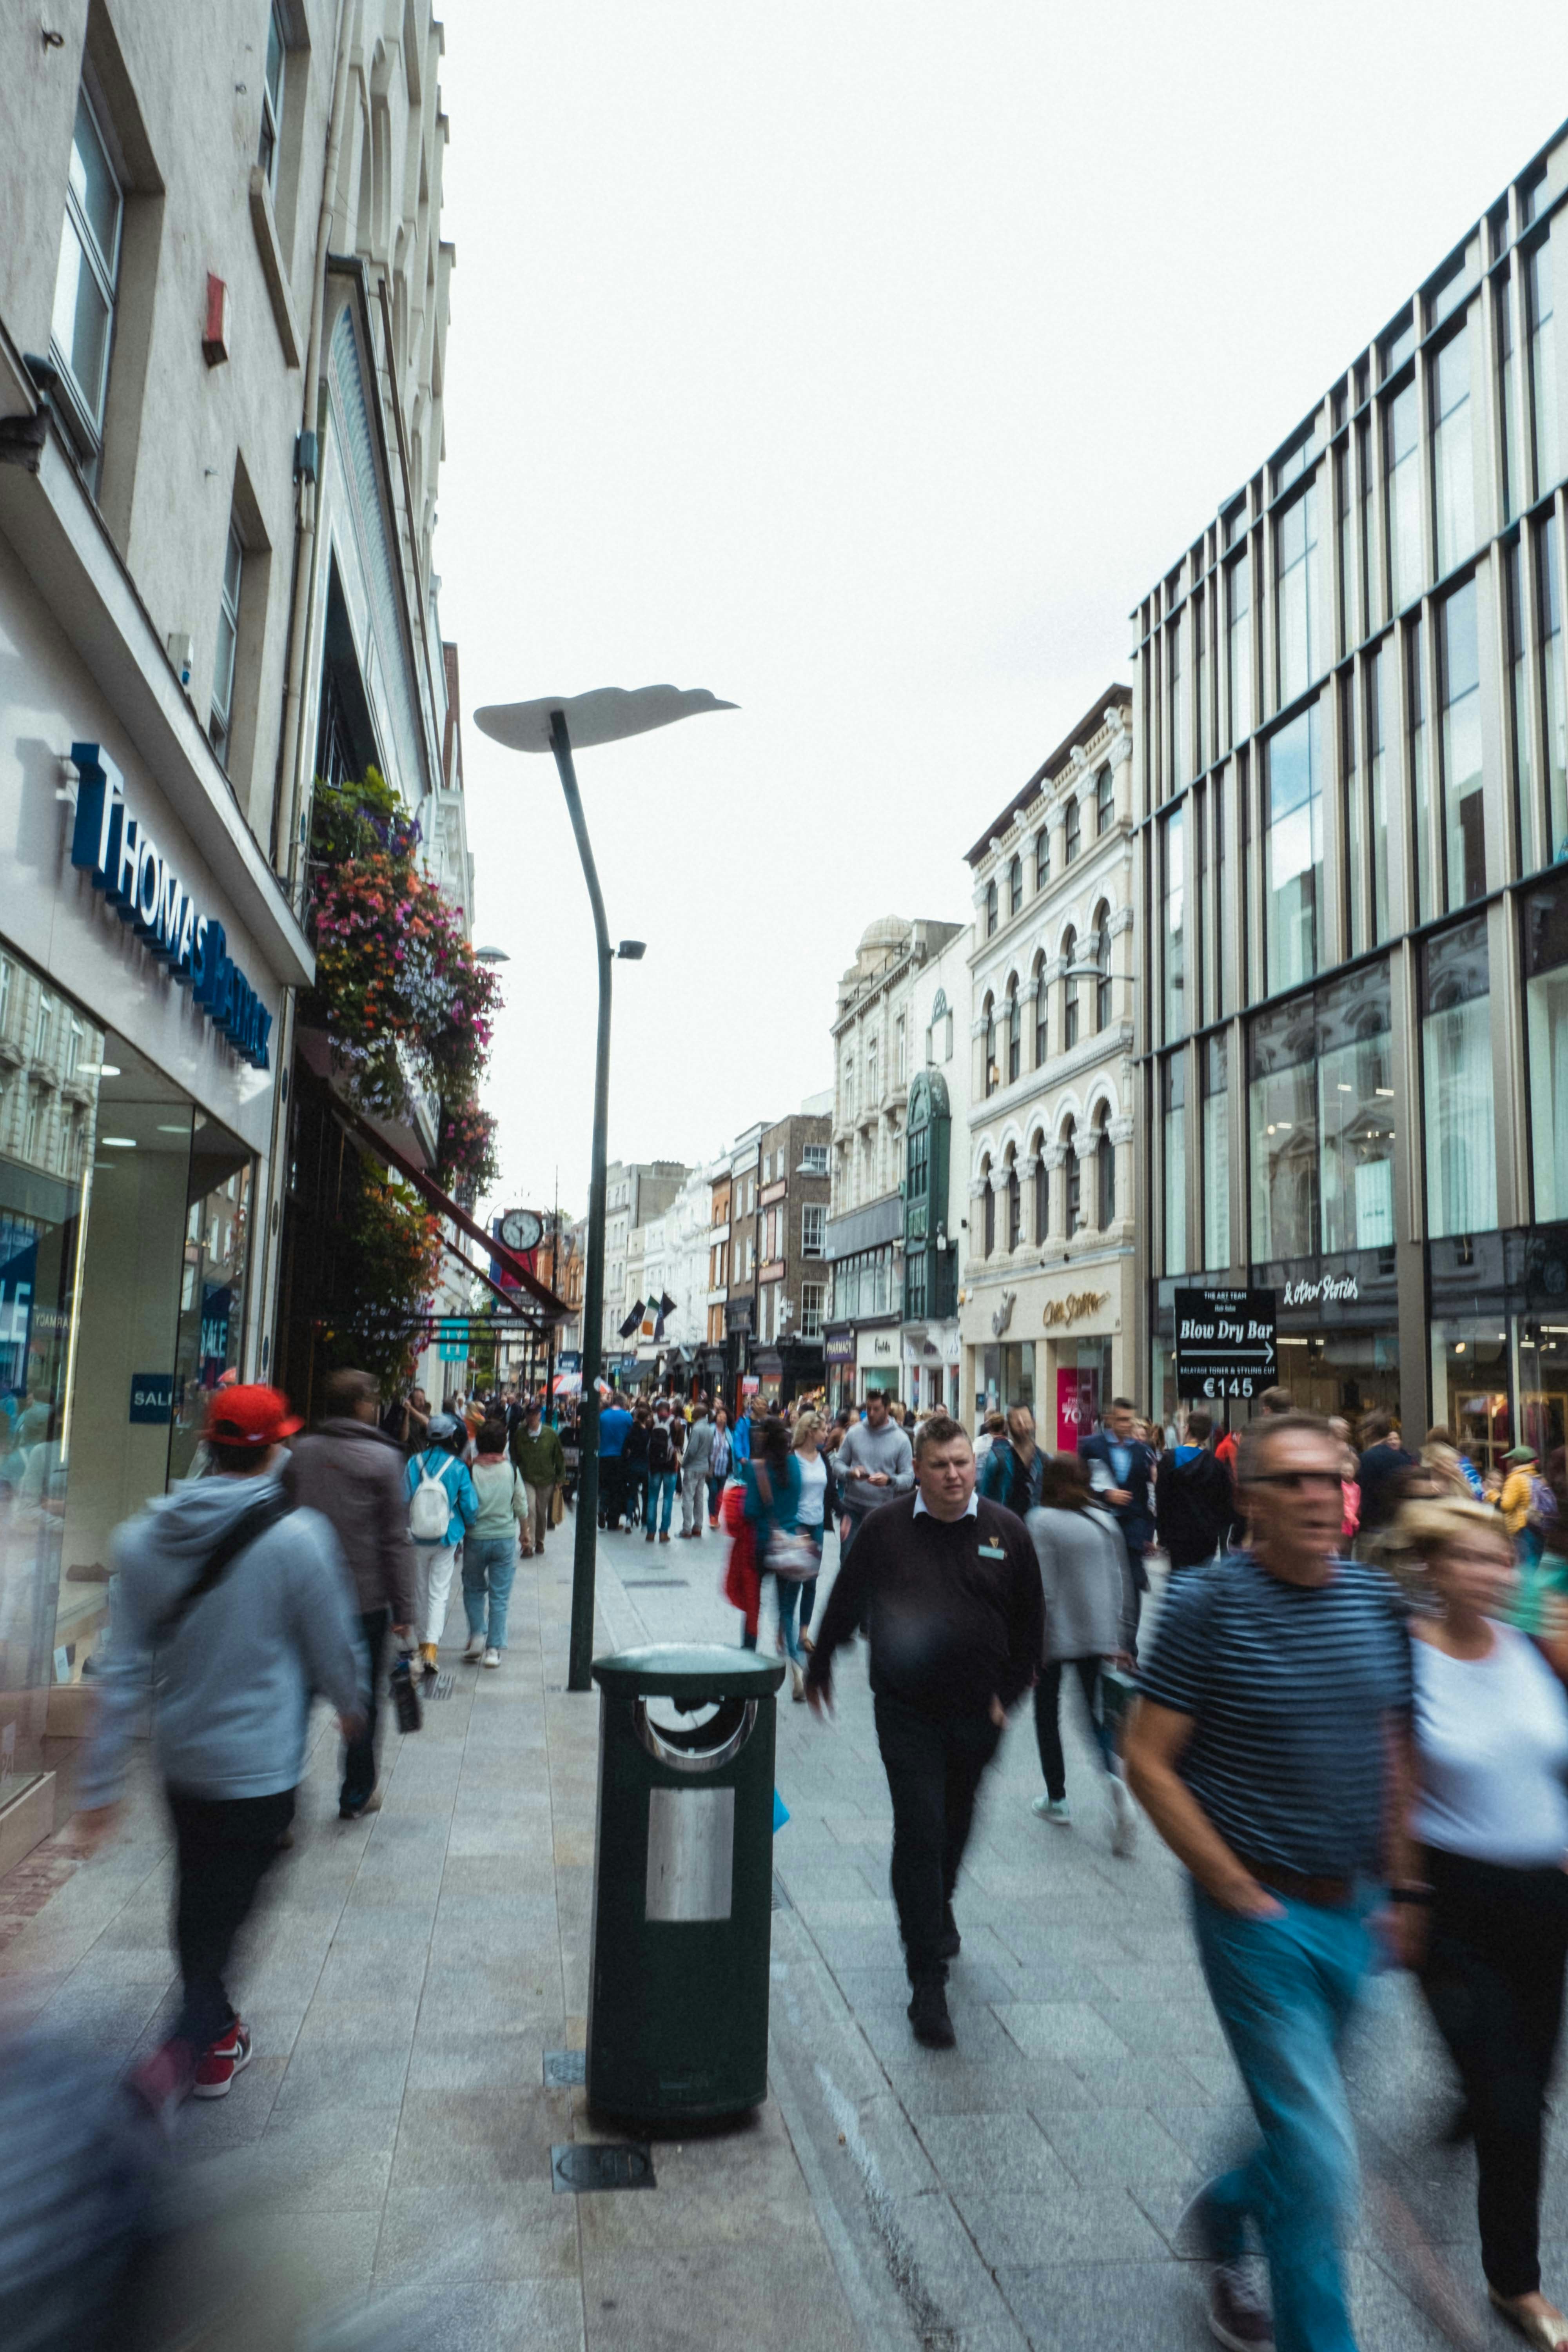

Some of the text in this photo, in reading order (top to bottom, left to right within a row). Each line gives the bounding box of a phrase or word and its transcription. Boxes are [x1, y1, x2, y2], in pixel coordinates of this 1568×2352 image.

[71, 742, 208, 987] THOMAS
[1204, 1291, 1215, 1300] THE
[1230, 1291, 1247, 1300] TEAM
[1283, 1274, 1358, 1306] & other Stories
[200, 1318, 228, 1358] SALE
[1180, 1319, 1273, 1343] Blow Dry Bar
[826, 1339, 851, 1355] PHARMACY
[1180, 1366, 1276, 1374] BALAYAGE TONER & STYLING CUT
[1203, 1377, 1253, 1398] €145
